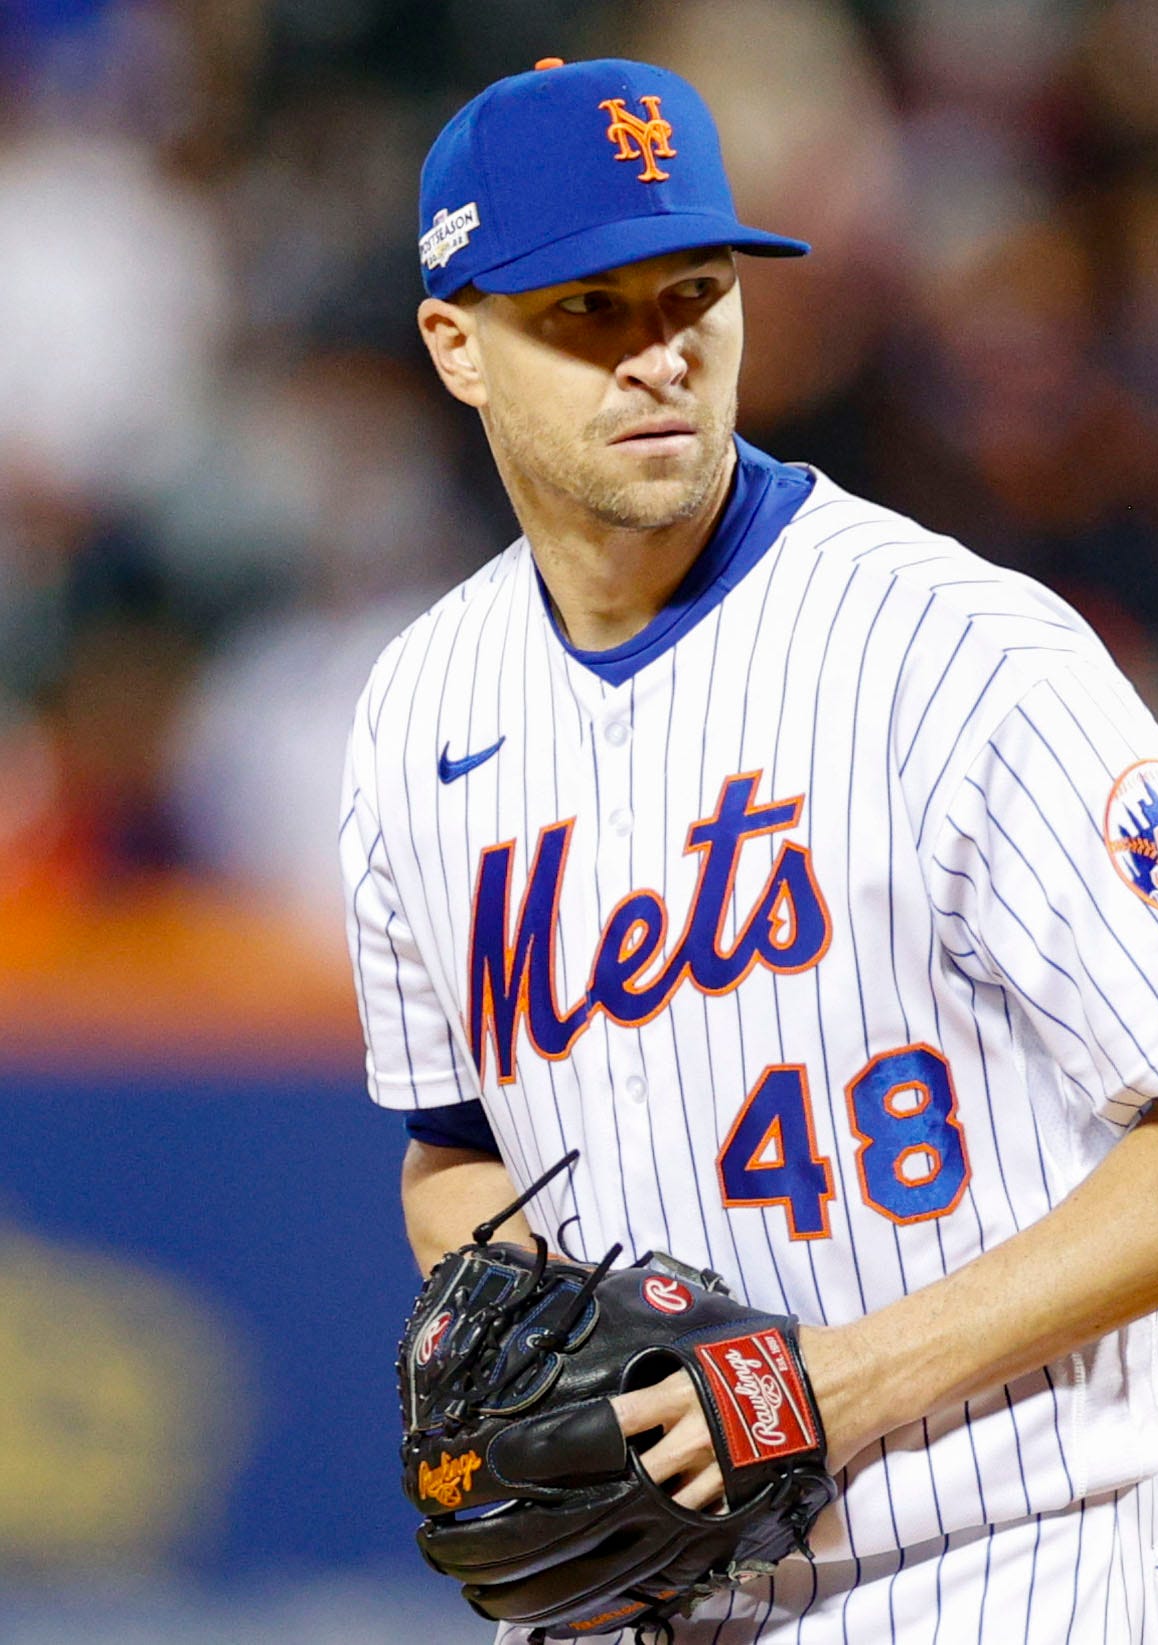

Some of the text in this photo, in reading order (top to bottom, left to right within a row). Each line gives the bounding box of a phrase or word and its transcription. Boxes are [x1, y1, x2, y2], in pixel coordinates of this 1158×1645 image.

[466, 769, 833, 1092] Mets
[715, 1042, 973, 1242] 48
[724, 1348, 787, 1446] Rawlings
